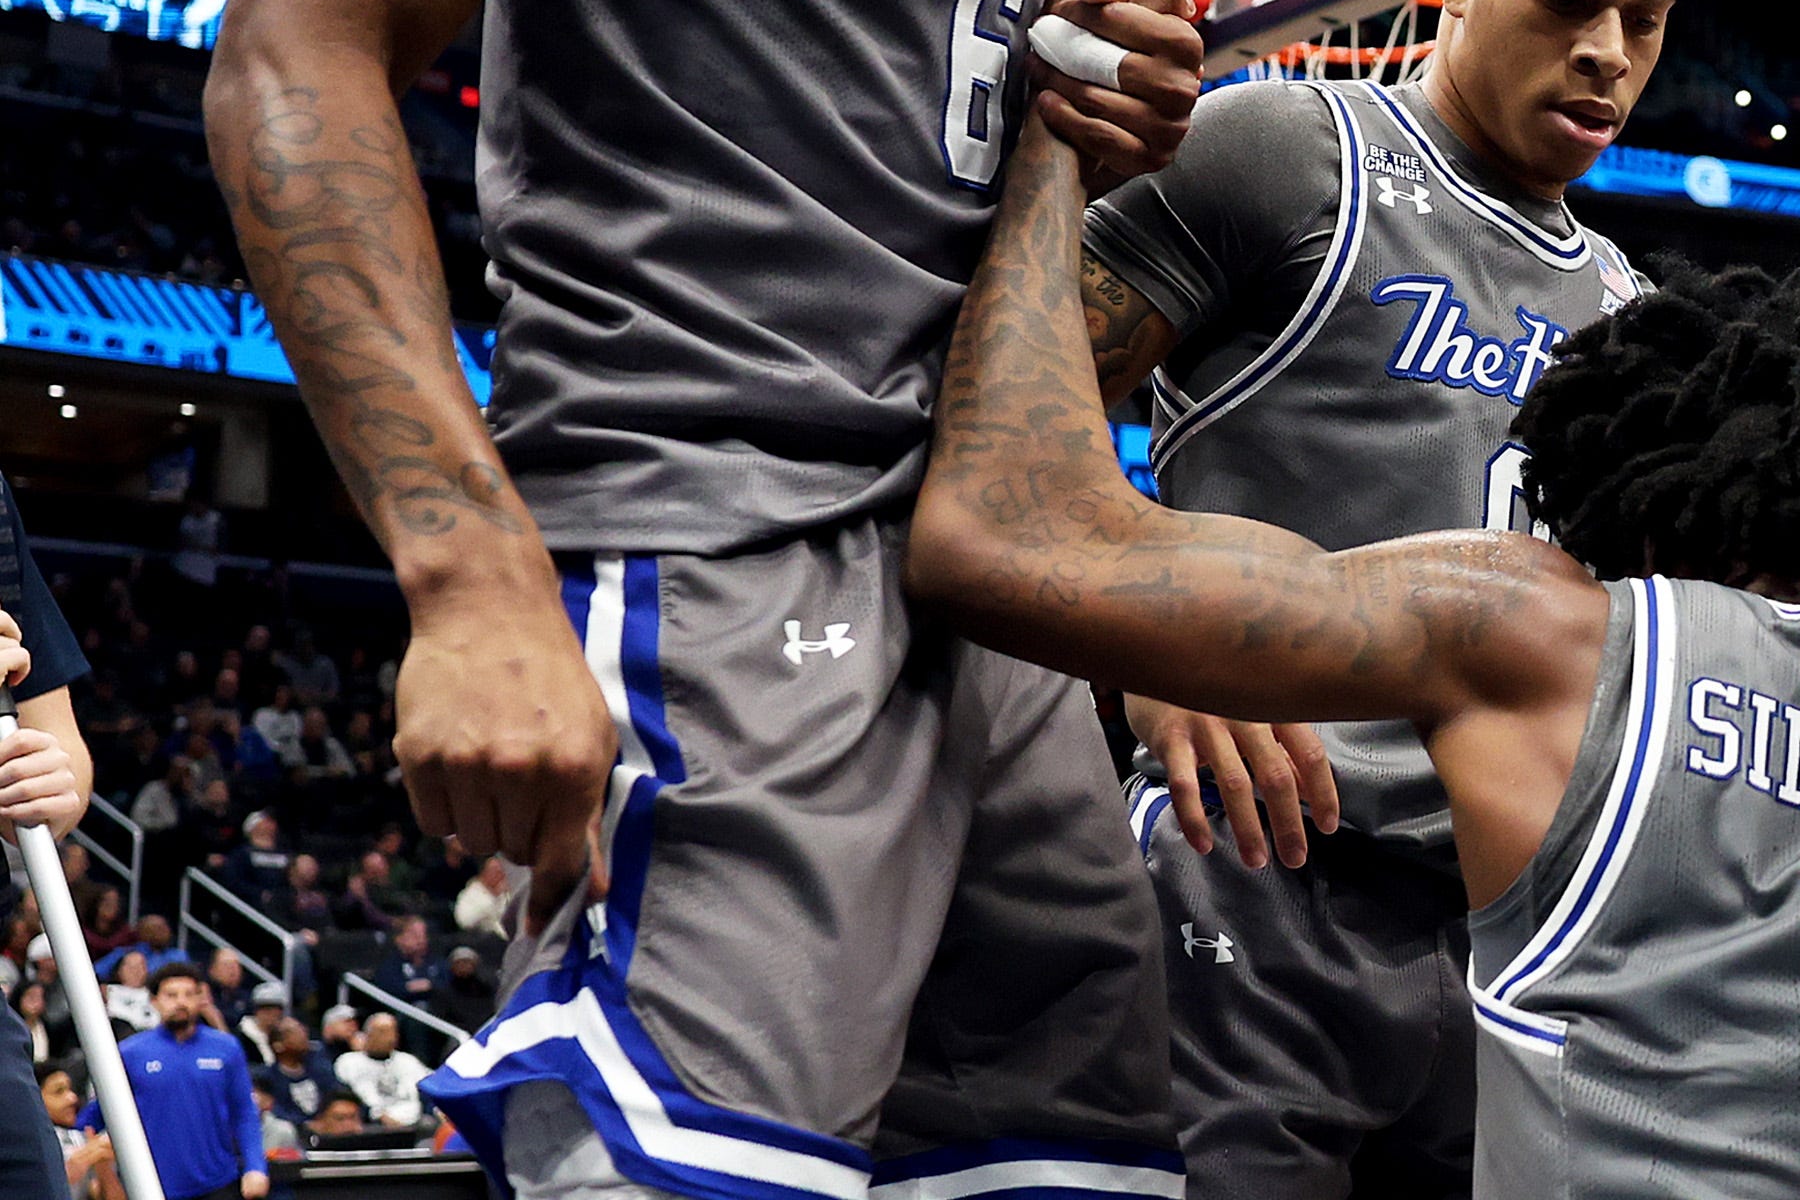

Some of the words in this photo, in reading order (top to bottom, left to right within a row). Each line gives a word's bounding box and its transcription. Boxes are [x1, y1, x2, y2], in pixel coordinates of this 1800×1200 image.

[1363, 155, 1426, 183] CHANGE
[1368, 143, 1389, 162] BE
[1390, 151, 1420, 170] THE
